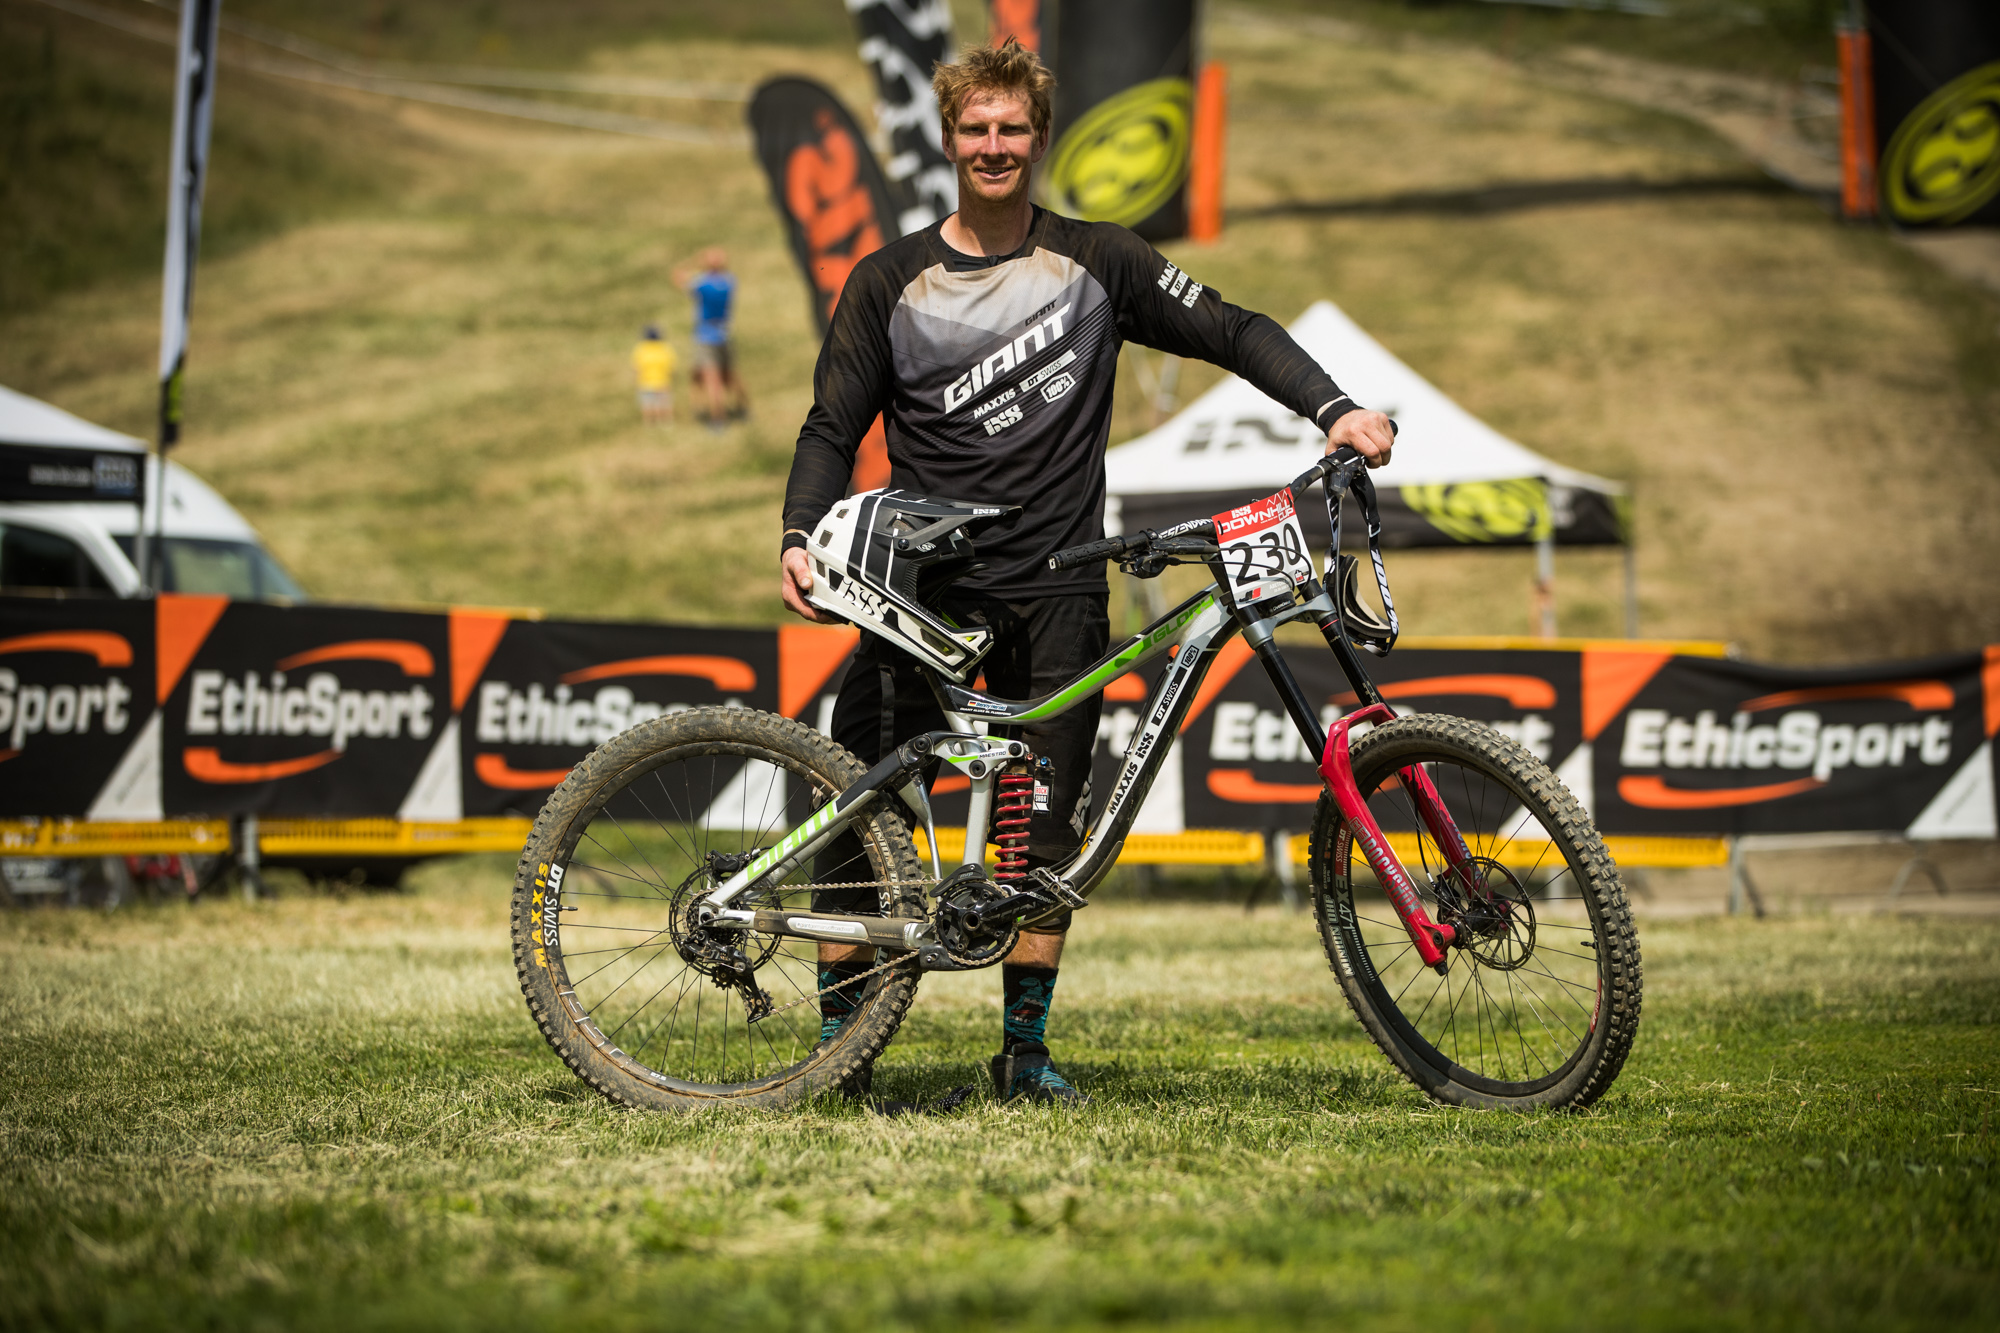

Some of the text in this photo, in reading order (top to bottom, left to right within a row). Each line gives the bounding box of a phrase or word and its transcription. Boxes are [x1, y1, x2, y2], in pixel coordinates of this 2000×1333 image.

[1025, 298, 1058, 327] GIANT
[943, 301, 1072, 415] GIANT
[1027, 360, 1062, 388] DT SWISS
[973, 387, 1017, 420] MAXXIS
[1045, 375, 1071, 399] 100%
[1217, 499, 1292, 536] DOWNHILL
[1278, 507, 1294, 522] CUP
[1225, 522, 1302, 588] 230
[1369, 548, 1400, 636] 100%
[1183, 647, 1197, 666] 100%
[185, 669, 436, 754] EthicSport
[1154, 681, 1179, 721] DT SWISS
[979, 750, 1007, 759] MAESTRO
[1620, 708, 1953, 783] EthicSport
[1034, 794, 1047, 803] SHOX
[1035, 787, 1048, 795] ROCK
[1107, 761, 1139, 816] MAXXIS
[1335, 828, 1347, 863] DT SWISS
[1361, 837, 1421, 917] ROCKSHOX
[531, 862, 549, 969] MAXXIS
[543, 862, 565, 947] DT SWISS
[1329, 924, 1356, 979] MINION
